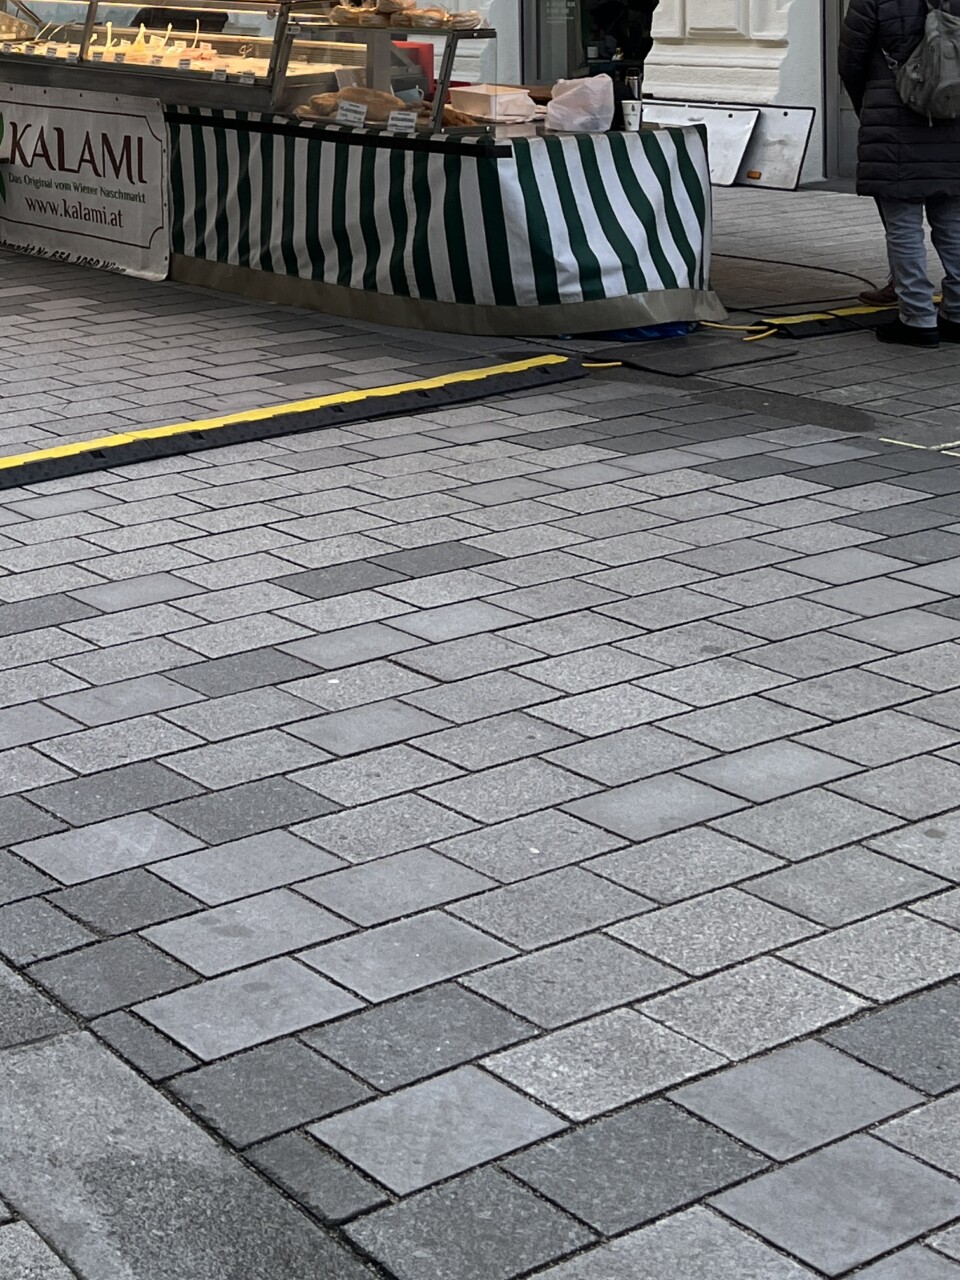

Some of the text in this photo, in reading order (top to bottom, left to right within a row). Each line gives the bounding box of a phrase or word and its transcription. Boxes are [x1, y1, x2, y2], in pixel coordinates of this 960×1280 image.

[9, 121, 148, 185] KALAMI
[8, 172, 146, 204] Das Original vom Wiener Naschmarkt
[24, 196, 124, 228] www.kalami.at
